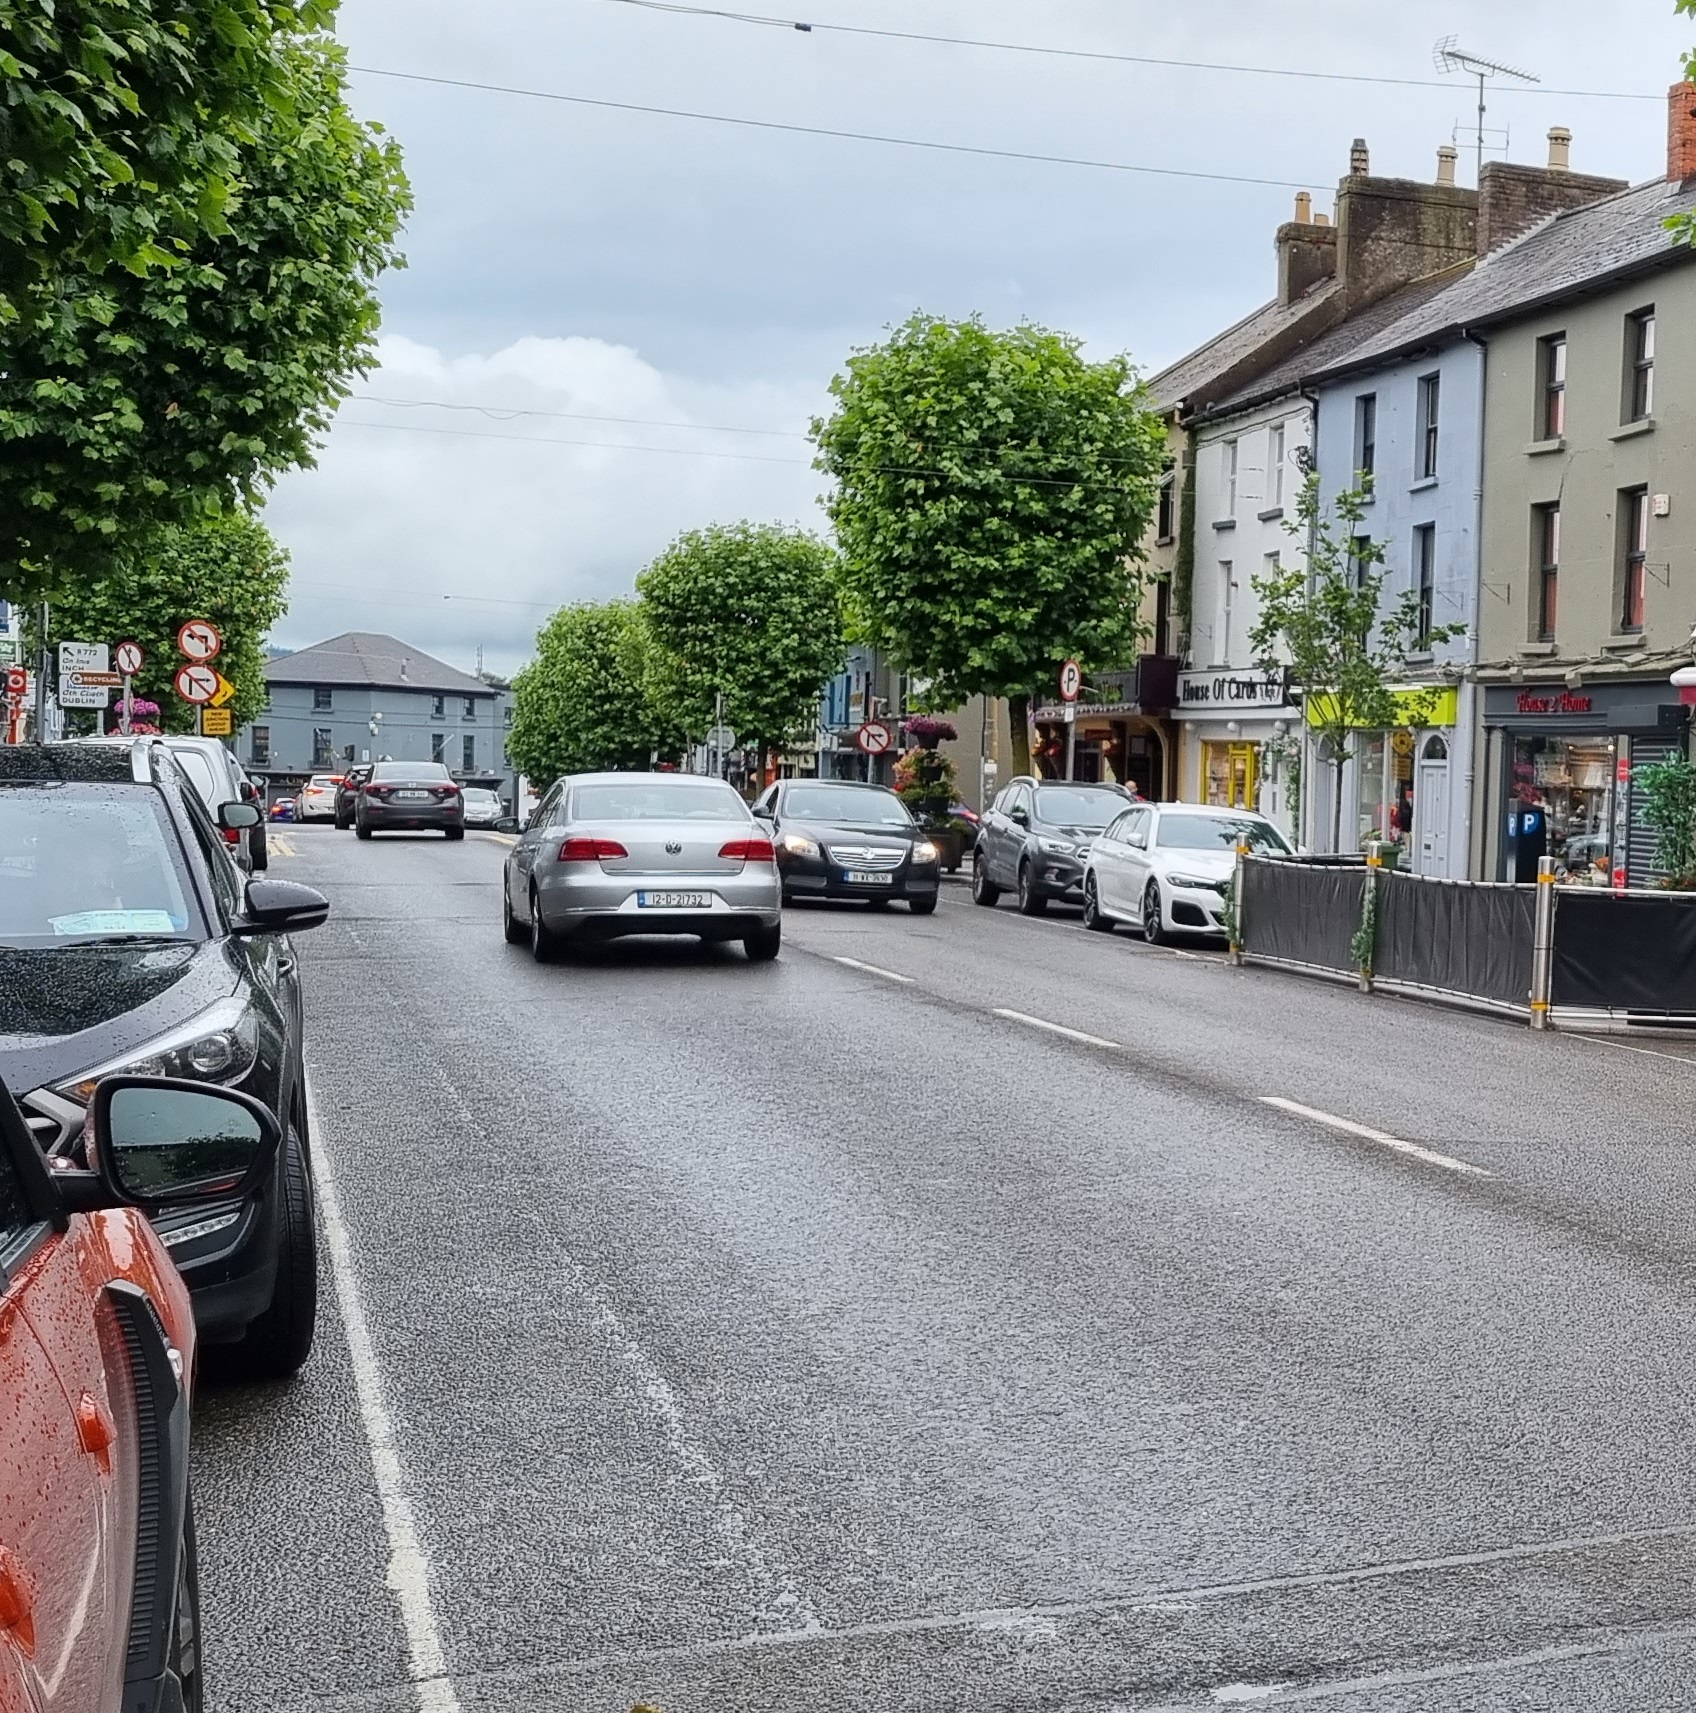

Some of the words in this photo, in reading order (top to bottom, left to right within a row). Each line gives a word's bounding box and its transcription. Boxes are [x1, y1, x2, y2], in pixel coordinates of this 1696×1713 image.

[1183, 680, 1210, 701] House
[1228, 676, 1258, 700] Cards
[1560, 690, 1591, 712] Home
[1524, 814, 1535, 831] P
[652, 894, 704, 906] 12-D-21732
